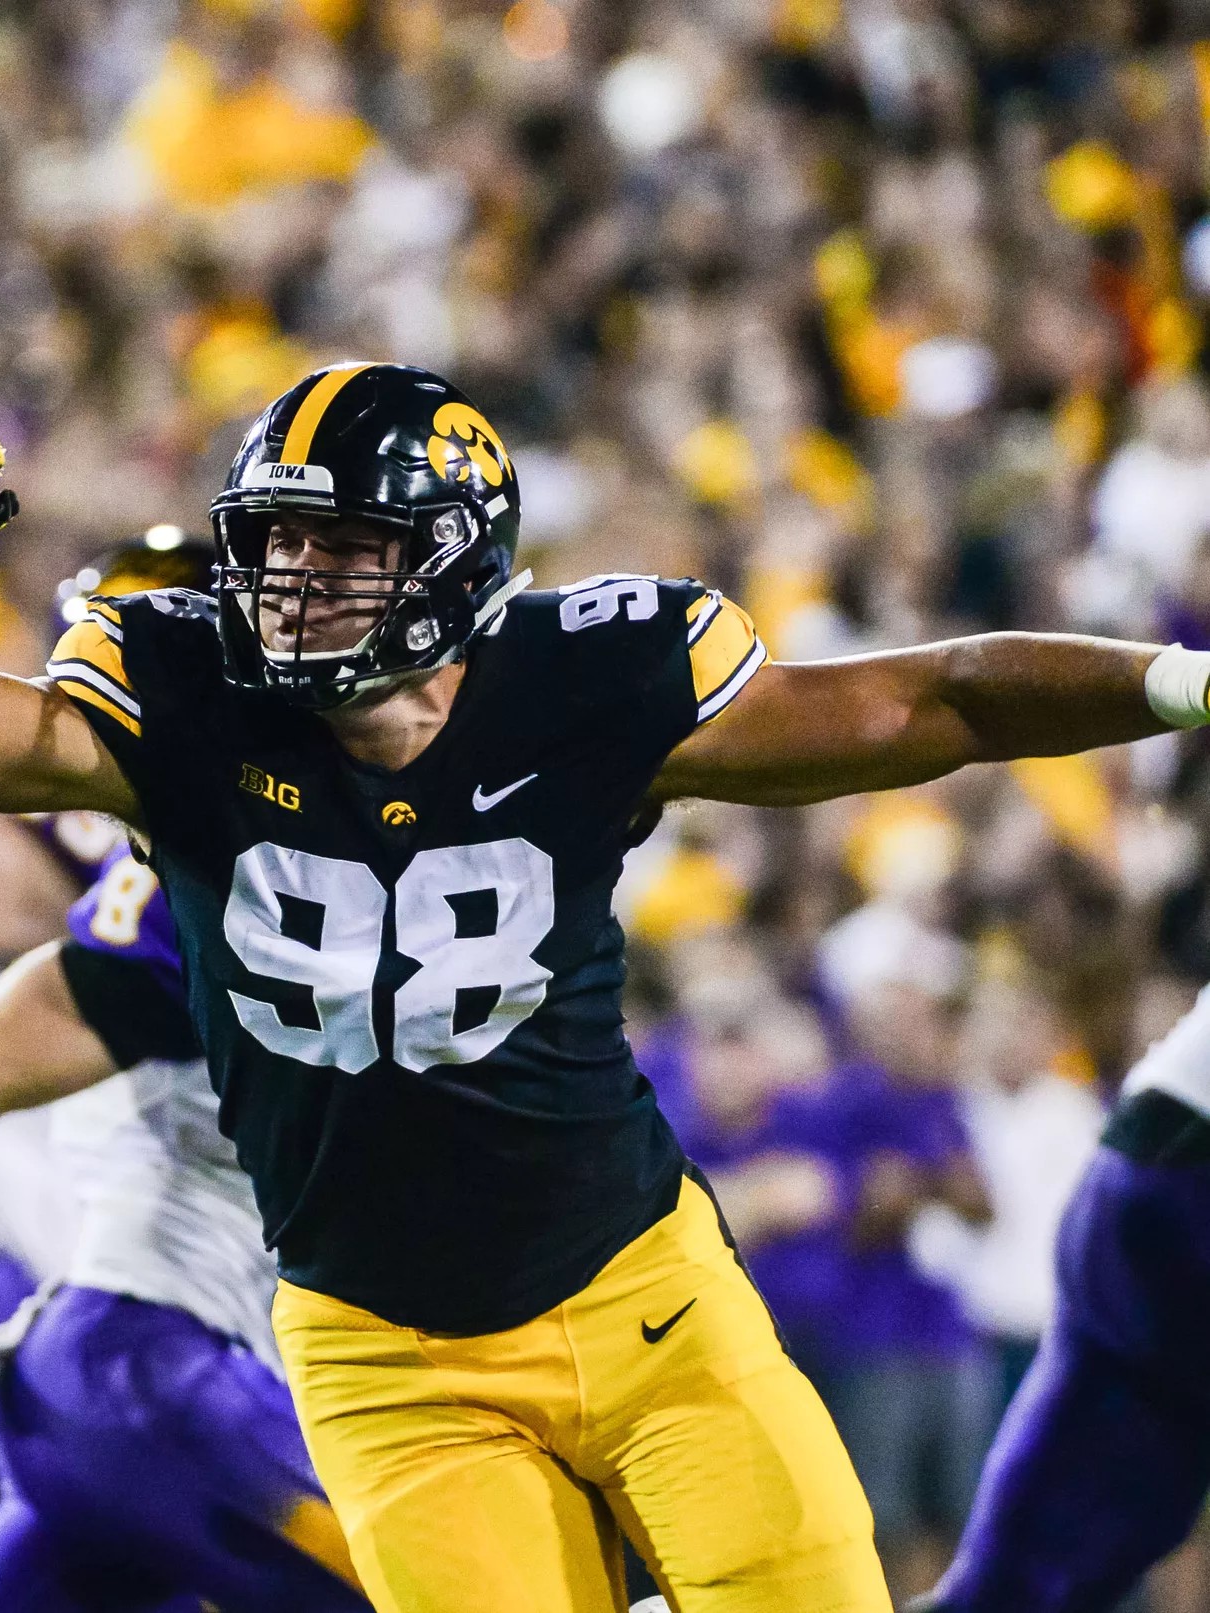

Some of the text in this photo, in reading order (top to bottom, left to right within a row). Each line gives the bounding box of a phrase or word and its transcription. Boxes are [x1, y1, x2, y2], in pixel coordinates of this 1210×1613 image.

[268, 464, 306, 480] IOWA
[278, 675, 311, 684] Ridell
[223, 837, 555, 1075] 98
